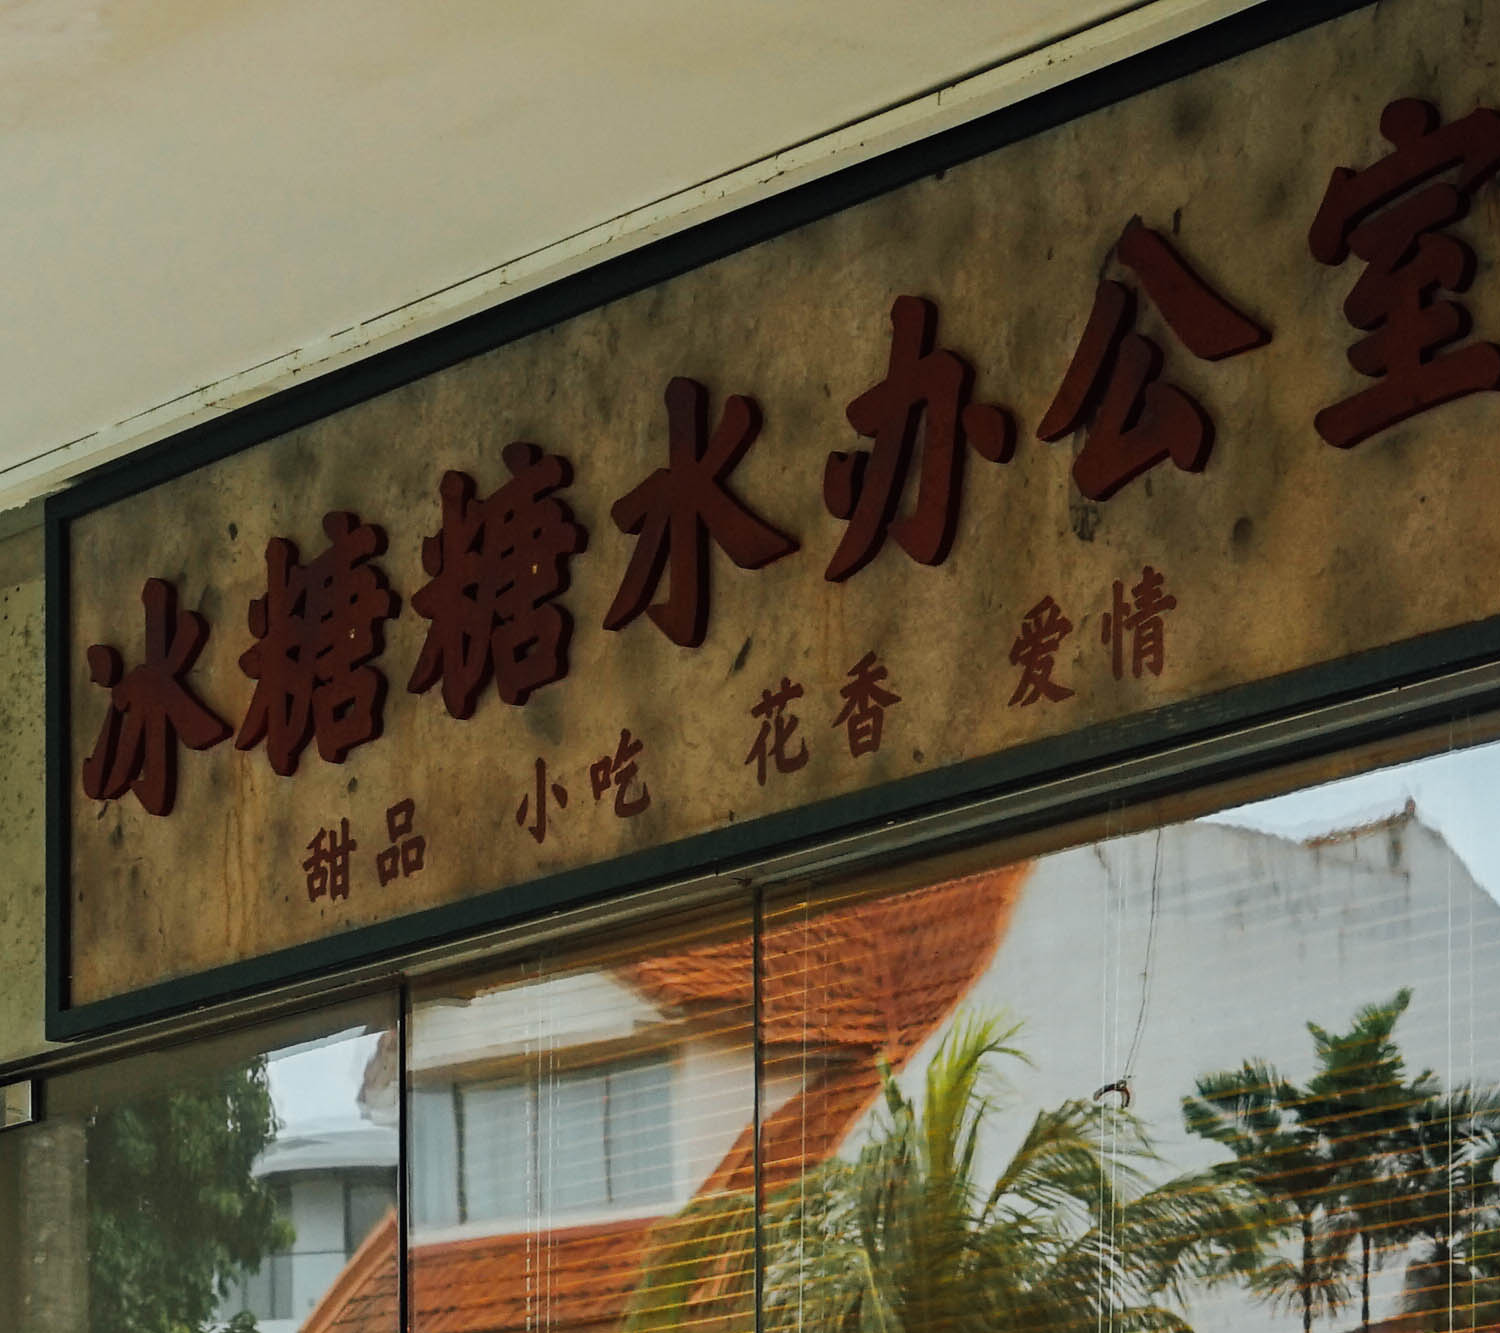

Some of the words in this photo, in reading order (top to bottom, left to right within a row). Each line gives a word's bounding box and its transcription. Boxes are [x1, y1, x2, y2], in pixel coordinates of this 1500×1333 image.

[302, 797, 426, 903] 甜品
[516, 728, 651, 843] 小吃
[744, 650, 901, 786] 花香
[1007, 566, 1177, 707] 爱情
